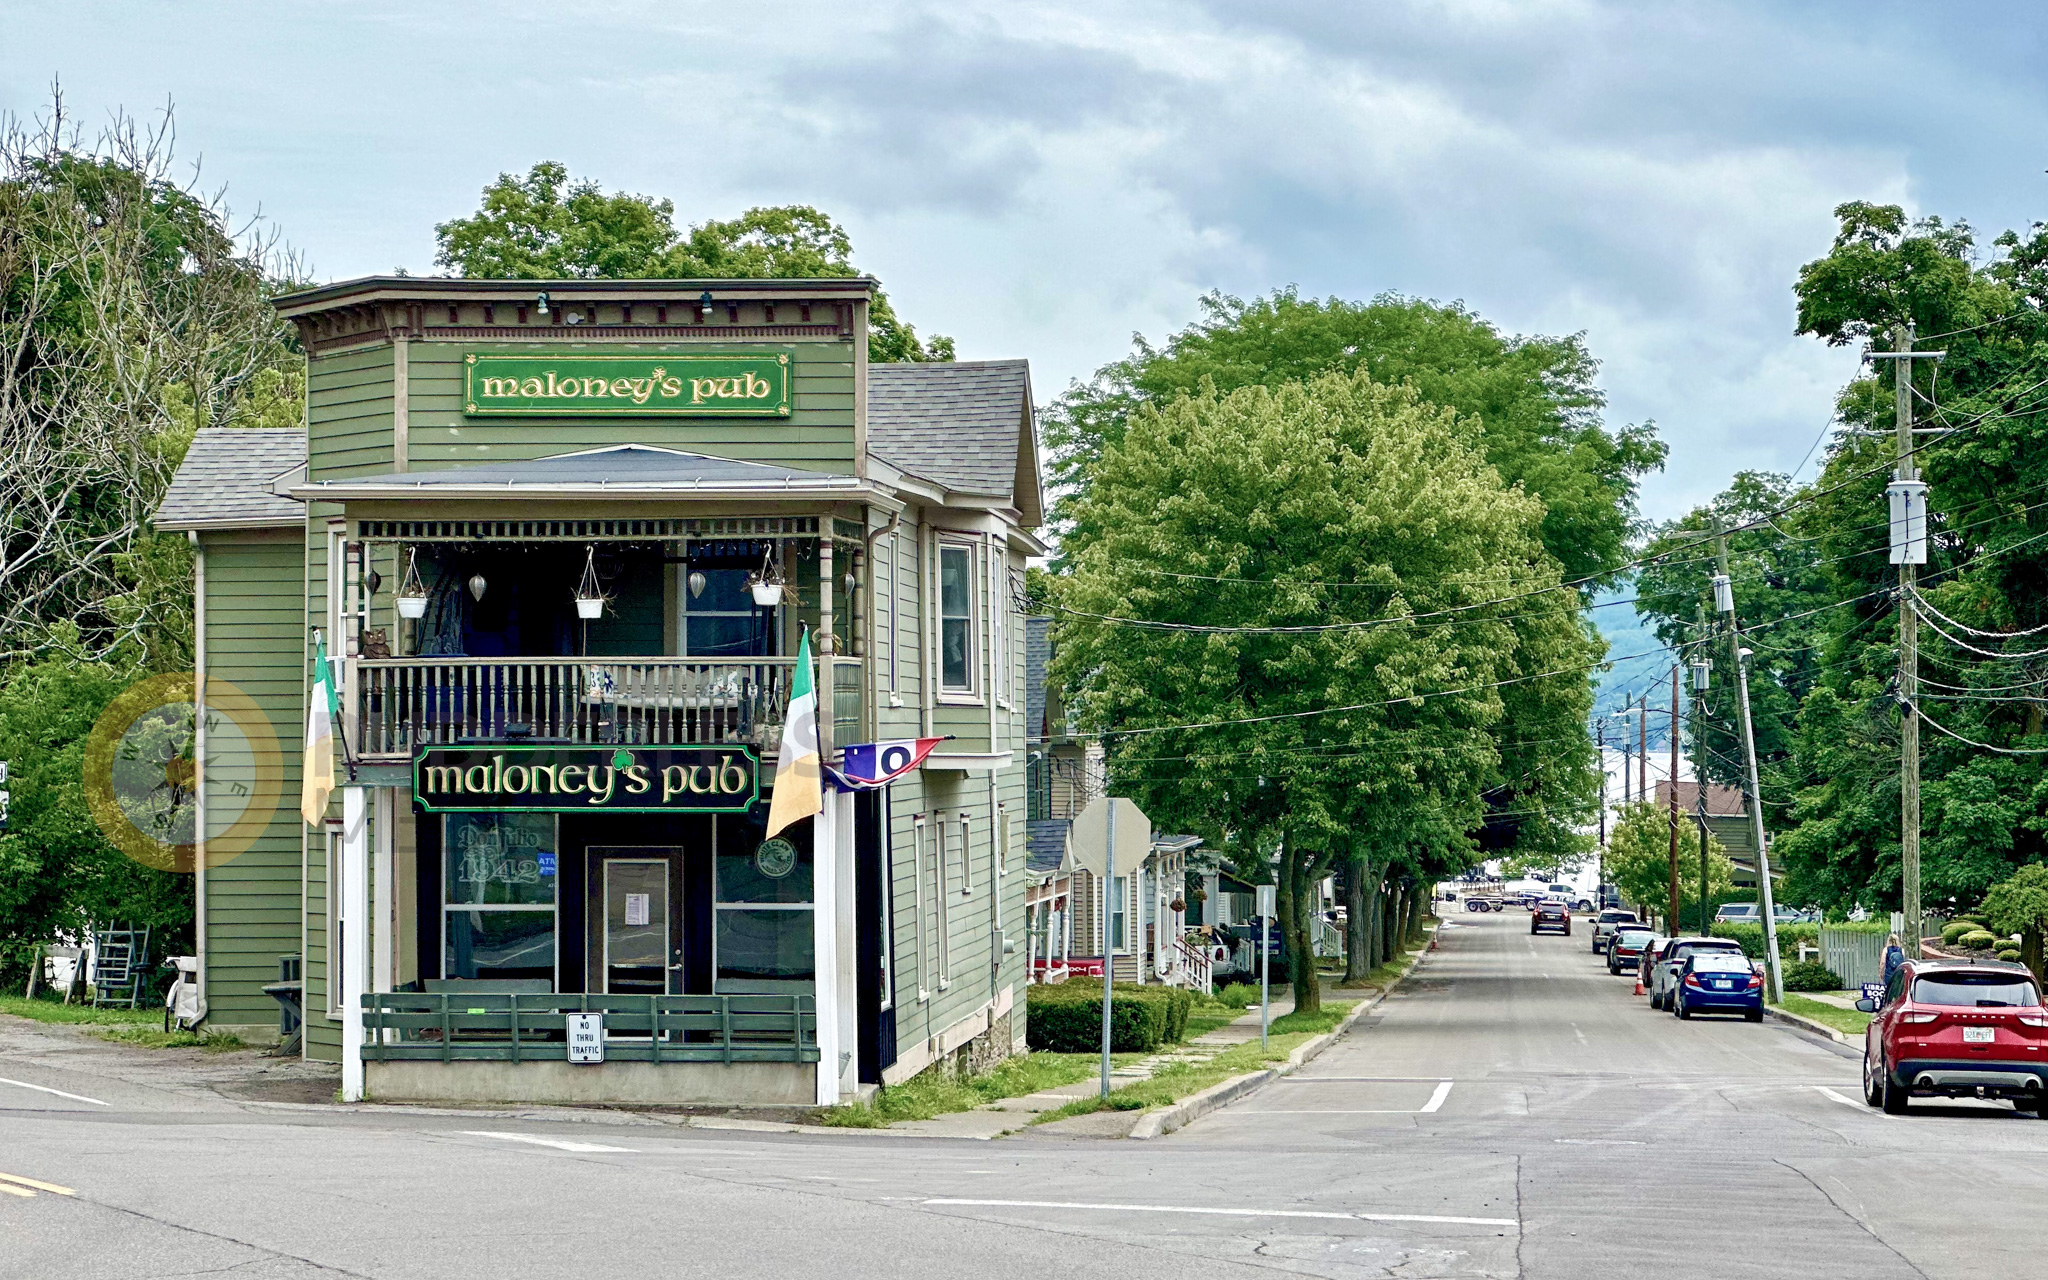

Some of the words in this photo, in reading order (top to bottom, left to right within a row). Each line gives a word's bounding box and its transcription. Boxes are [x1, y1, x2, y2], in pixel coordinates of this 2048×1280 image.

[481, 369, 683, 405] maloney's
[687, 371, 771, 405] pub
[424, 754, 651, 804] maloney's
[660, 754, 748, 803] pub
[458, 858, 541, 883] 1942
[572, 1046, 599, 1054] TRAFFIC
[577, 1034, 594, 1042] THRU
